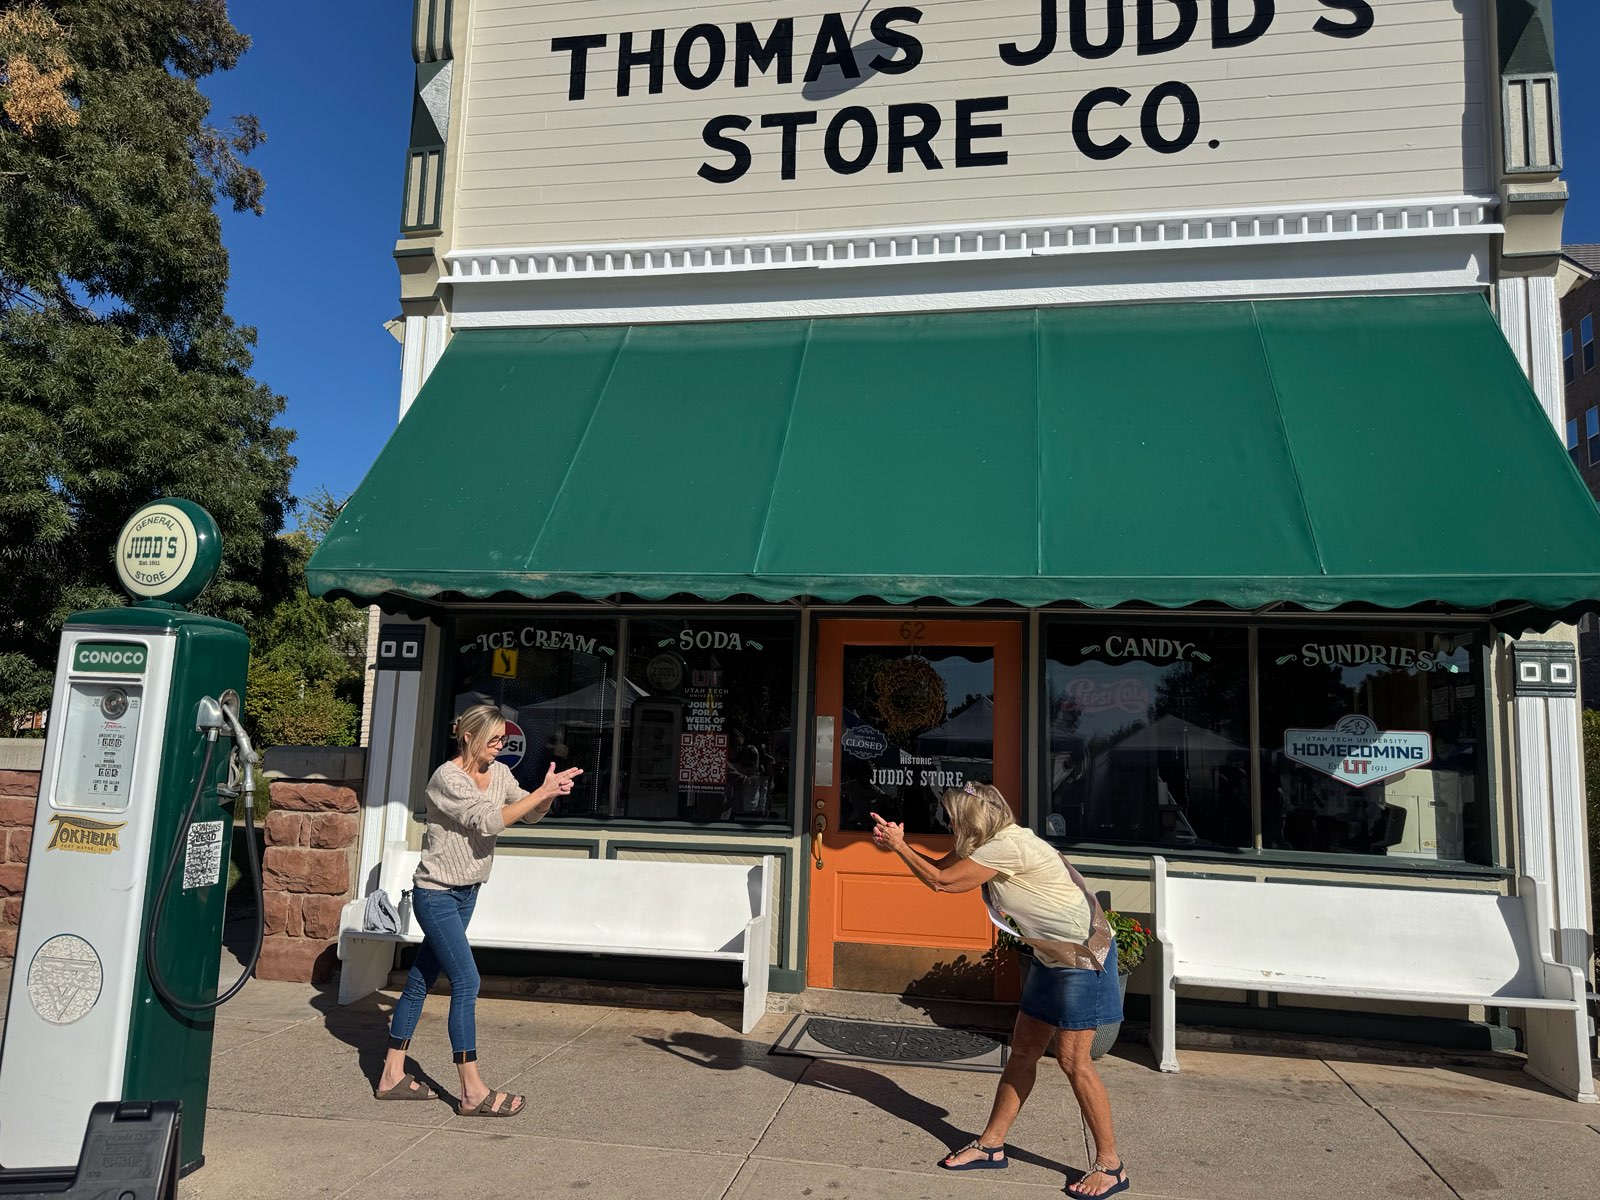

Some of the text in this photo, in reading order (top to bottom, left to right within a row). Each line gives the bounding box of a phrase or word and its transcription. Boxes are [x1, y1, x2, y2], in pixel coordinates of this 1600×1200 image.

[551, 0, 1375, 101] THOMAS JUDDS
[697, 80, 1220, 184] STORE CO.
[135, 516, 175, 532] GENERAL
[127, 536, 177, 559] JUDD'S
[135, 570, 167, 583] STORE
[679, 629, 743, 651] SODA
[900, 621, 926, 640] 62
[476, 627, 598, 655] ICE CREAM
[1105, 635, 1195, 660] CANDY
[79, 650, 144, 665] CONOCO
[1301, 642, 1436, 671] SUNDRIES
[685, 716, 711, 724] WEEK
[845, 738, 883, 750] CLOSED
[1292, 742, 1423, 760] HOMECOMING
[900, 756, 932, 766] HISTORIC
[1328, 762, 1343, 770] Est.
[1343, 759, 1372, 774] UT
[869, 768, 964, 788] JUDD'S STORE
[48, 814, 125, 849] TOKHEIM
